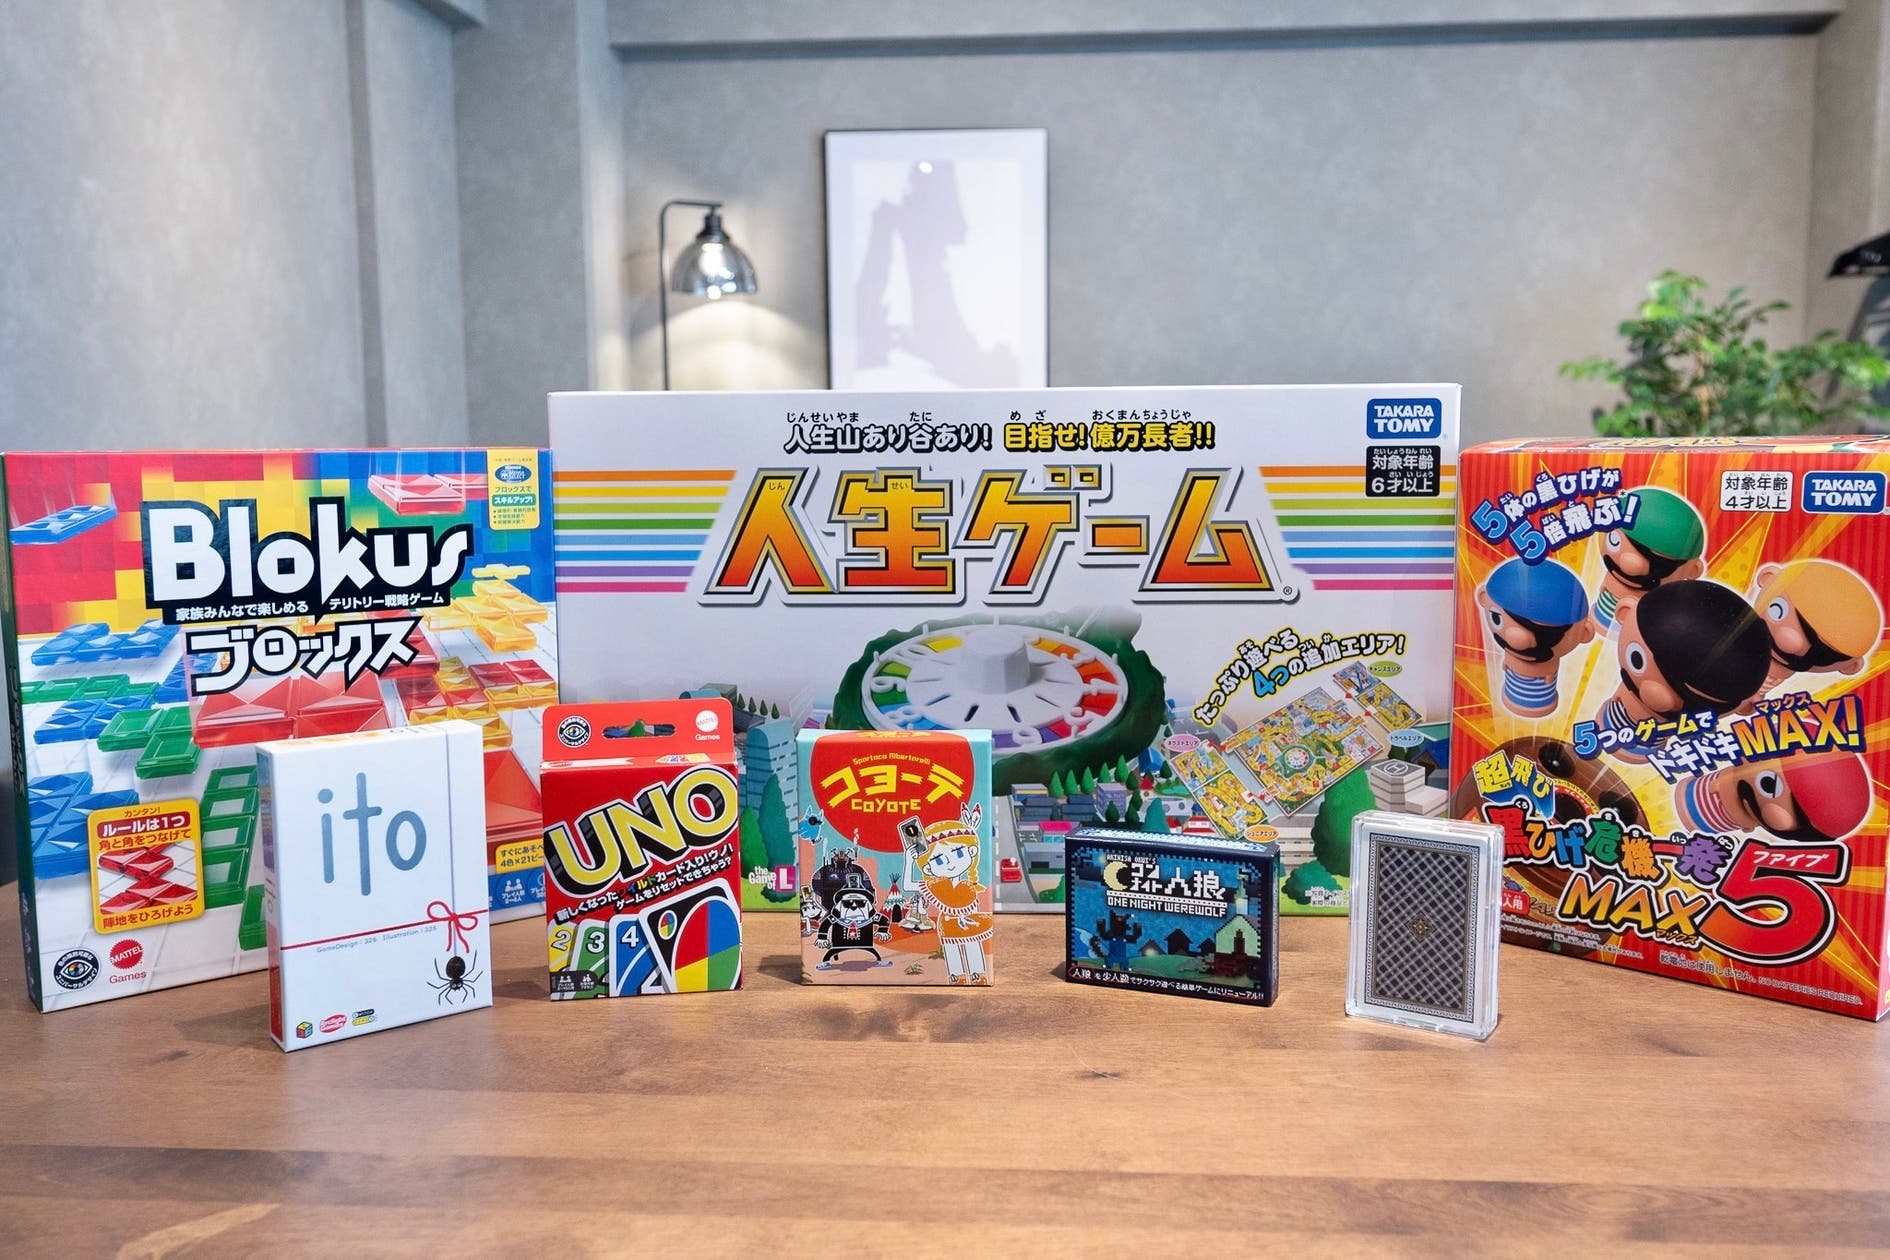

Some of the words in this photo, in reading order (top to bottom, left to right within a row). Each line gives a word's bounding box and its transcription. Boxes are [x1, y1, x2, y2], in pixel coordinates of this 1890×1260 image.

[909, 411, 932, 422] たに
[1010, 410, 1021, 421] め
[1035, 410, 1047, 421] ざ
[1092, 409, 1192, 421] おくまんちょうじゃ
[1373, 405, 1435, 417] TAKARA
[1373, 418, 1435, 433] TOMY
[784, 423, 992, 452] 人生山あり谷あり!
[1372, 455, 1434, 470] 対象年齢
[1371, 477, 1433, 493] 6才以上
[1725, 477, 1788, 491] 対象年齢
[1811, 479, 1877, 492] TAKARA
[1472, 468, 1621, 539] 5体の黒ひげが
[1725, 495, 1788, 509] 4才以上
[1811, 492, 1877, 507] TOMY
[704, 464, 1278, 595] 人生ゲーム
[149, 503, 468, 602] Blokus
[175, 600, 309, 621] 家族みんなで楽しめる
[329, 592, 445, 611] テリトリー戦略ゲーム
[188, 618, 418, 693] ブロックス
[1194, 628, 1300, 725] たっぷり遊べる
[1757, 692, 1811, 713] マックス
[695, 733, 721, 741] Games
[1574, 711, 1714, 754] 5つのゲームで
[820, 763, 966, 809] コヨーテ
[1475, 752, 1553, 799] 超飛び
[124, 807, 160, 817] カンタン!
[851, 798, 921, 814] COYOTE
[103, 815, 185, 837] ルールは1つ
[318, 772, 427, 896] ito
[547, 768, 738, 887] UNO
[99, 829, 192, 850] 角と角をつなげて
[1488, 805, 1729, 882] 黒ひげ危機一発
[1754, 850, 1828, 868] ファイブ
[748, 872, 777, 885] Game
[754, 865, 768, 875] the
[767, 880, 776, 890] of
[1164, 867, 1226, 900] 人狼
[1107, 896, 1128, 907] ONE
[1129, 899, 1162, 912] NIGHT
[1164, 902, 1226, 918] WEREWOLF
[1561, 875, 1707, 935] MAX
[1700, 841, 1842, 959] 5
[103, 904, 194, 929] 陣地をひろげよう
[551, 930, 572, 951] 2
[587, 931, 605, 953] 3
[621, 926, 639, 947] 4
[1655, 928, 1698, 945] マックス
[111, 946, 144, 963] MATTEL
[109, 970, 148, 984] Games
